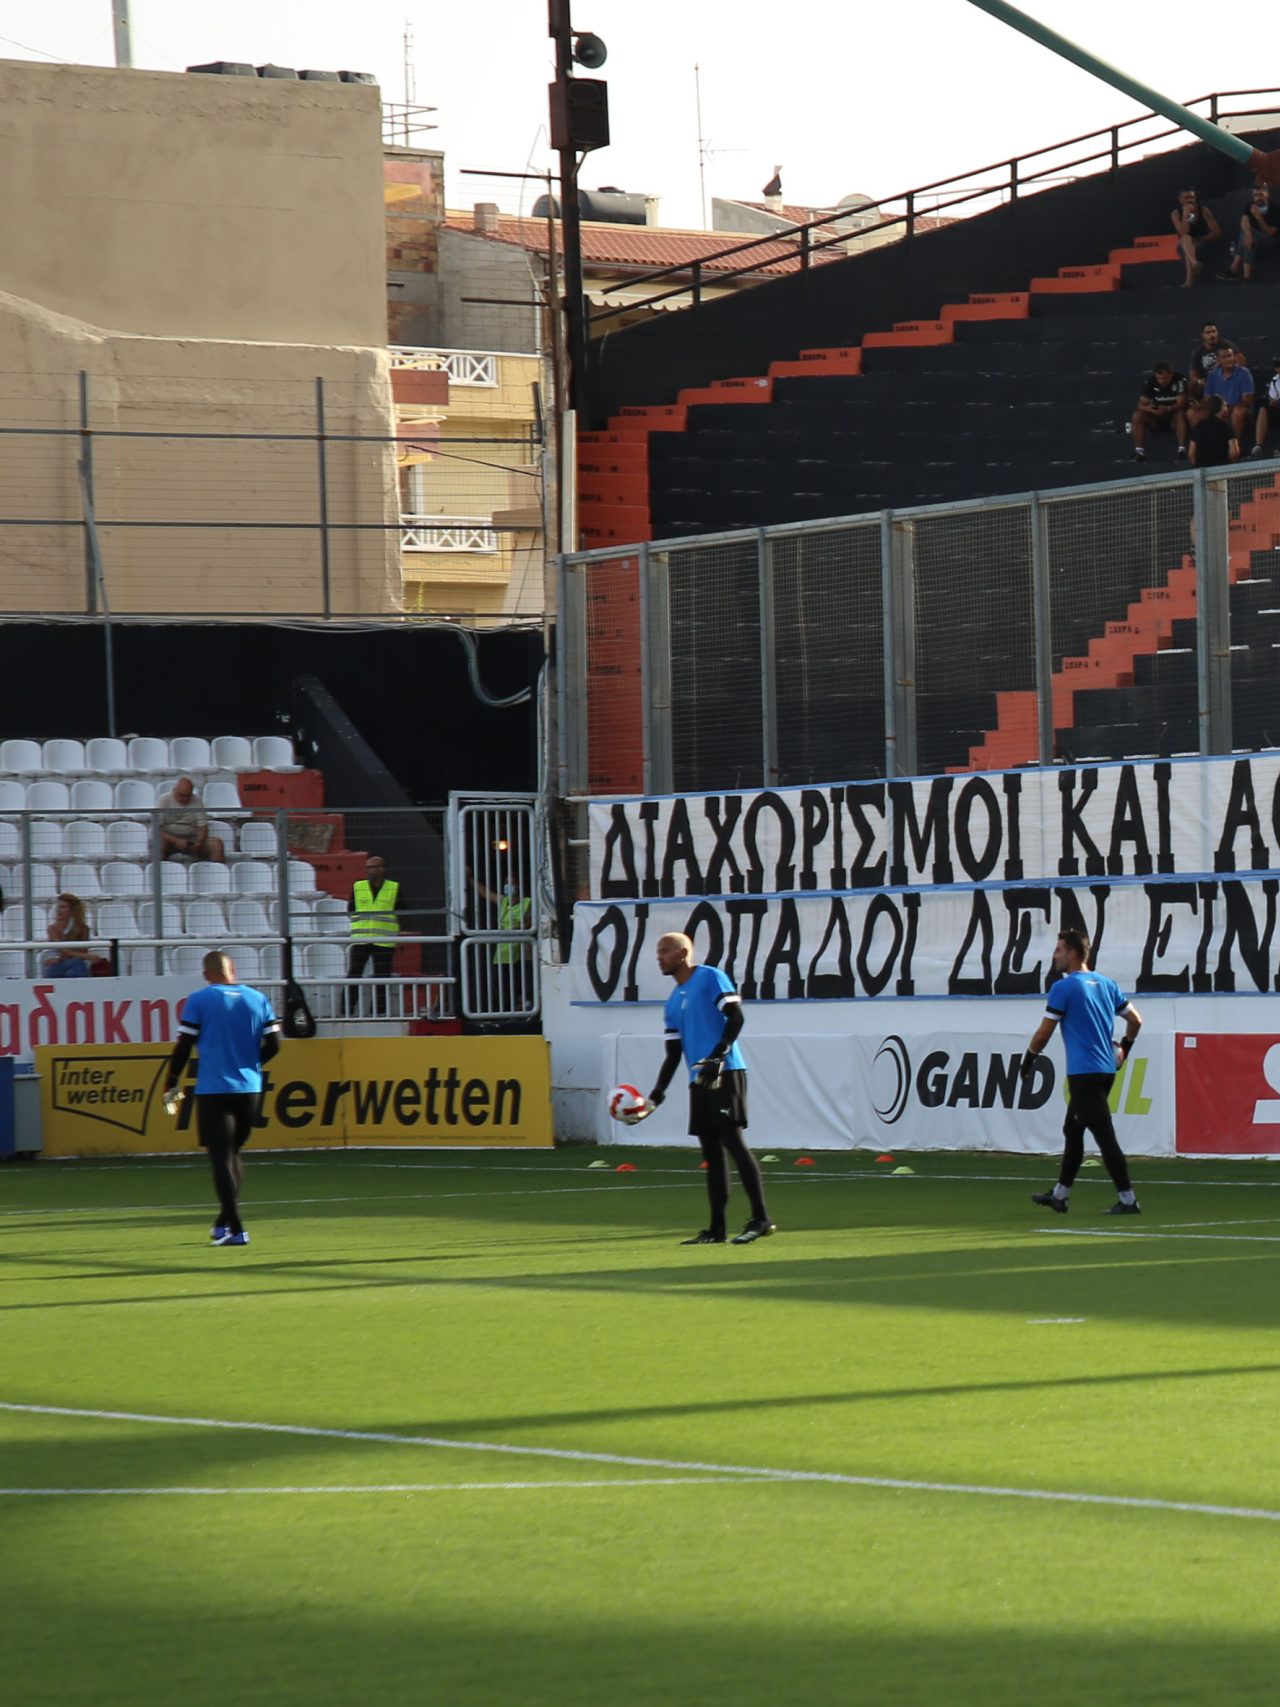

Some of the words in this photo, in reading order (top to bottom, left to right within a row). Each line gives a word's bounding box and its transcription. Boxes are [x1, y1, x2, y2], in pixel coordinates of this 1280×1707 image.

[601, 773, 1023, 898] ΔΙΑΧΩΡΙΣΜΟΙ
[1057, 762, 1174, 876] ΚΑΙ
[587, 903, 649, 1002] ΟΙ
[0, 985, 187, 1056] αδακη
[60, 1061, 115, 1085] inter
[67, 1086, 145, 1104] wetten
